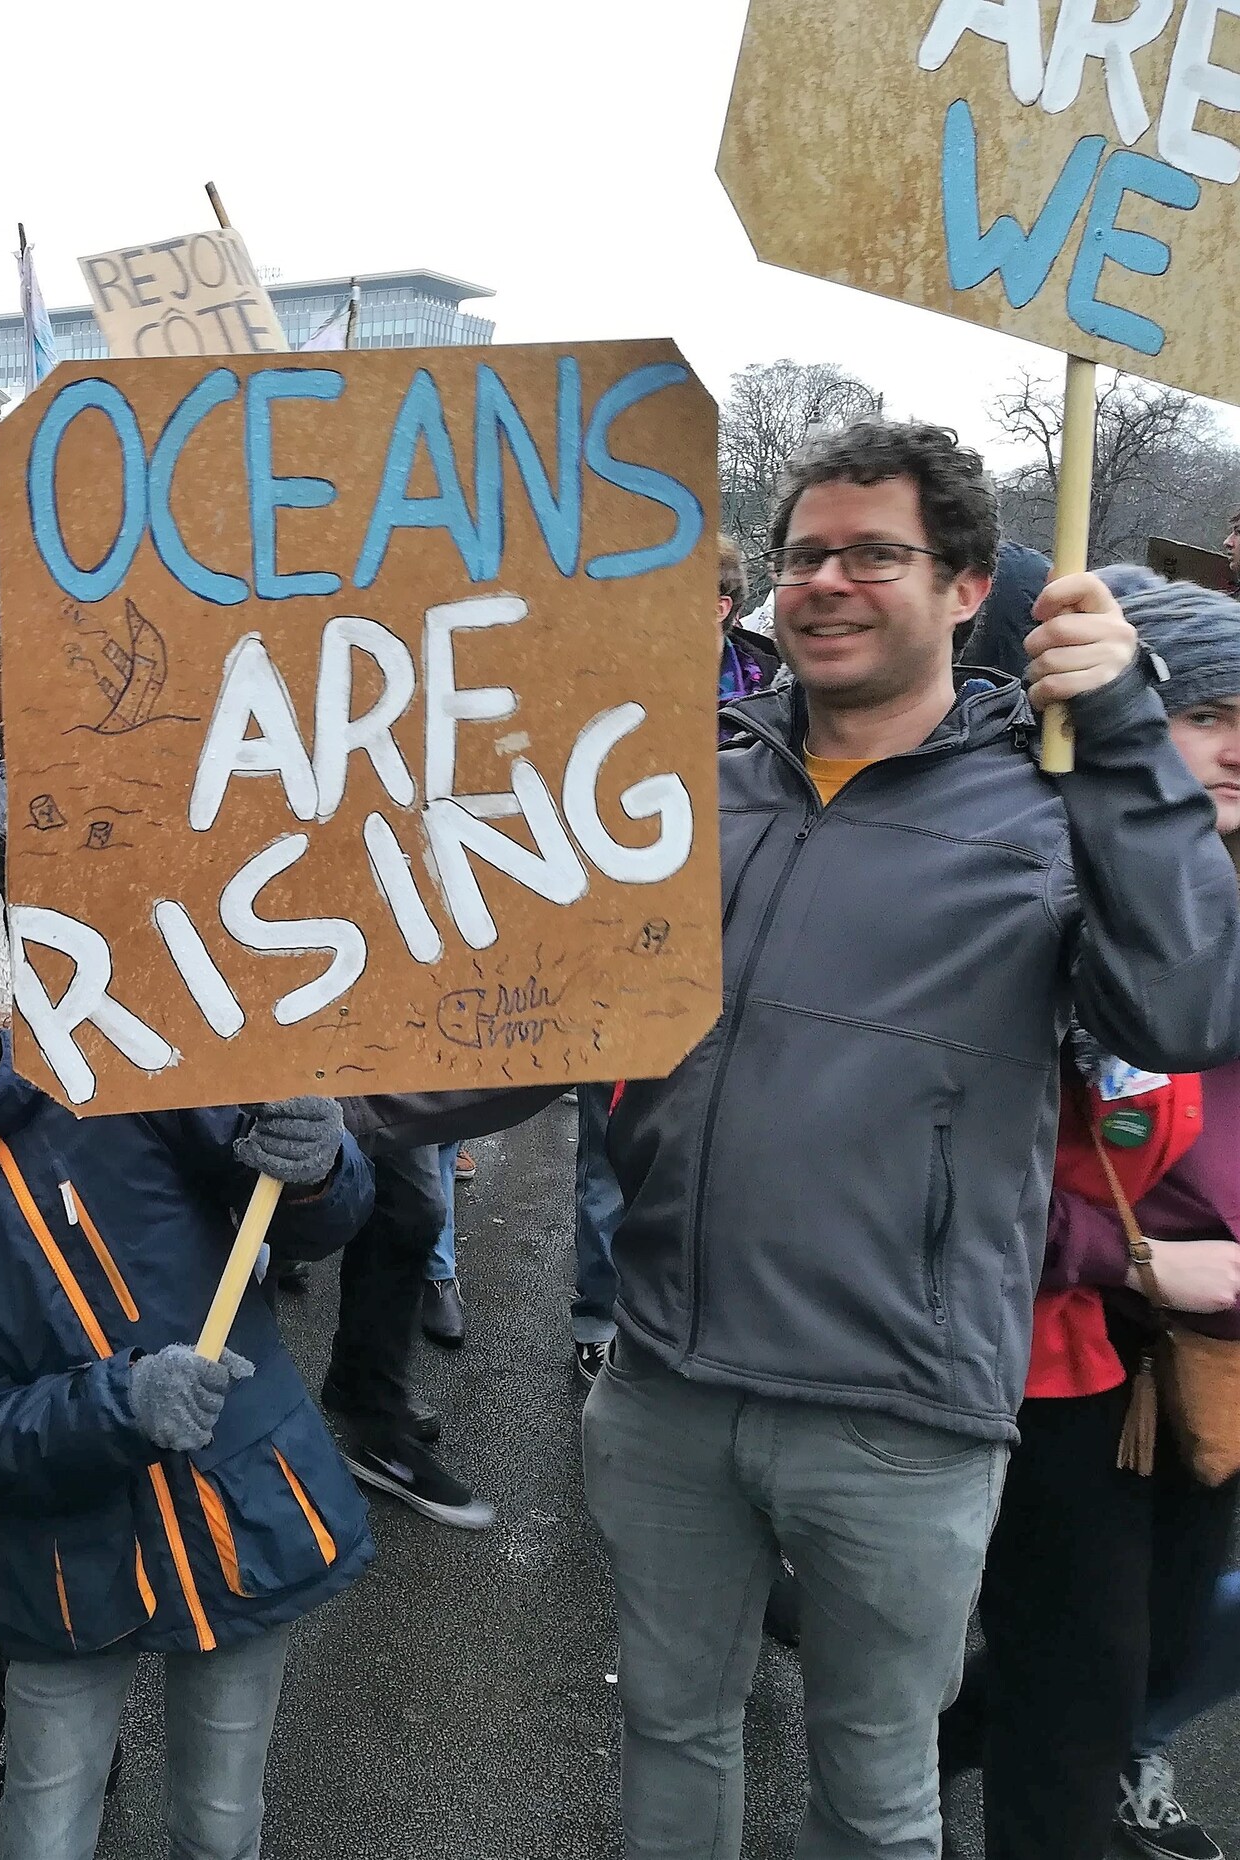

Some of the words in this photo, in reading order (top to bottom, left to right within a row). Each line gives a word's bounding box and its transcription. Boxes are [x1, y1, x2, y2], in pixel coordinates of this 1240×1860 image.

[941, 98, 1201, 357] WE
[27, 354, 705, 606] OCEANS
[187, 593, 530, 832] ARE
[8, 700, 694, 1104] RISING
